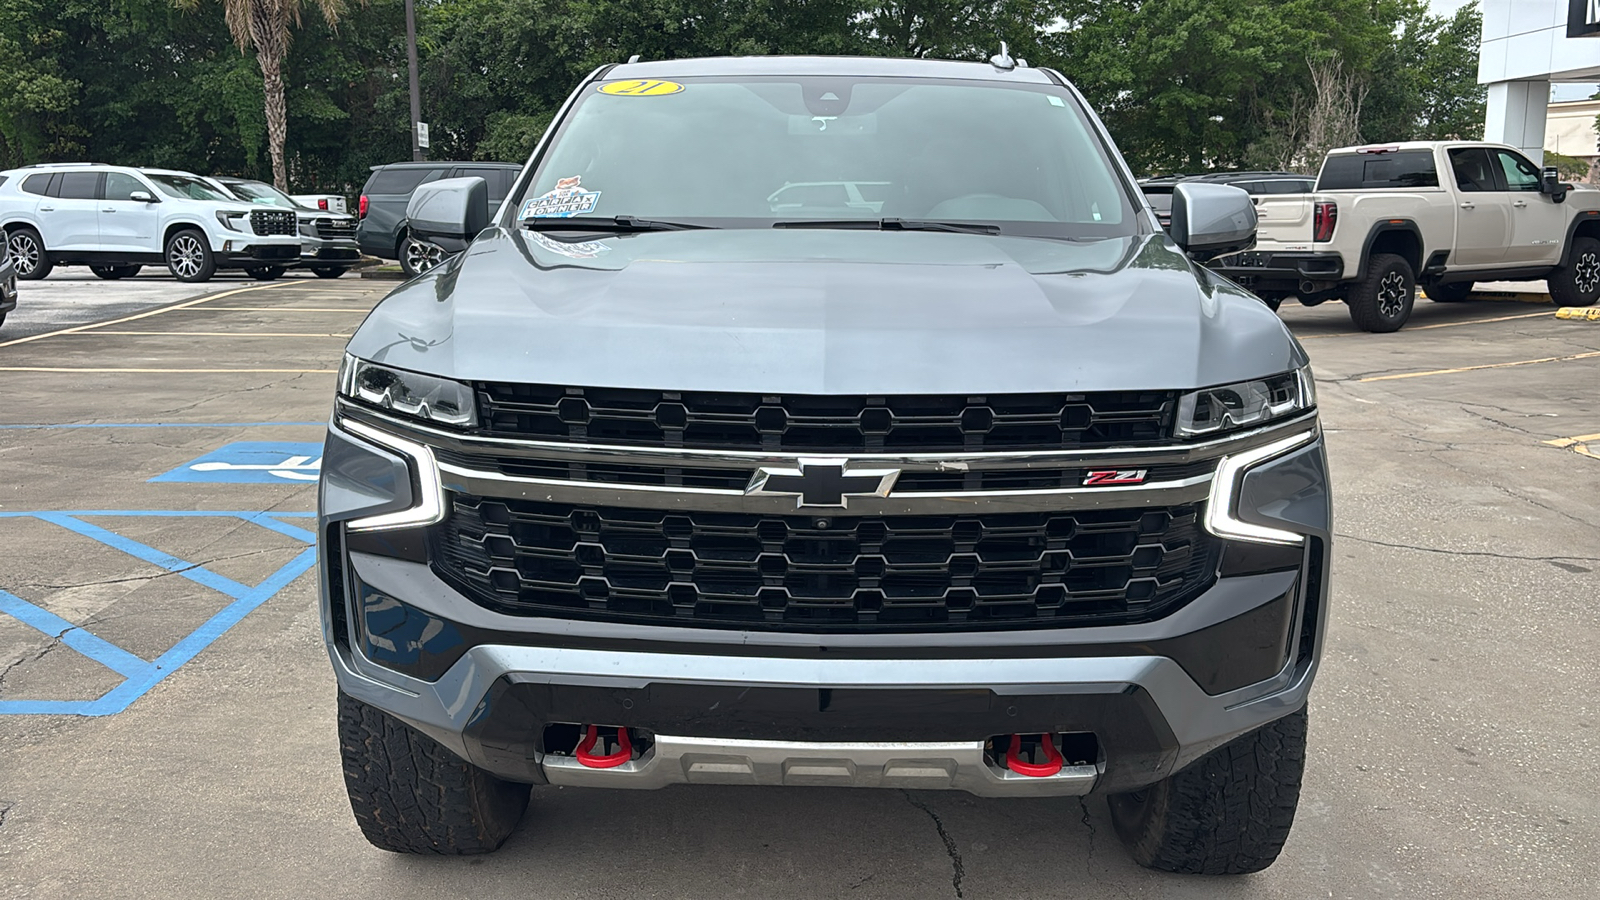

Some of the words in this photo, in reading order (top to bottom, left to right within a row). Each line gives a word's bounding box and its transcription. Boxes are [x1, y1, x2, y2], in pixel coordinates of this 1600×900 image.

[614, 81, 666, 93] 21
[527, 195, 593, 209] CARFAX
[1082, 470, 1147, 485] Z71
